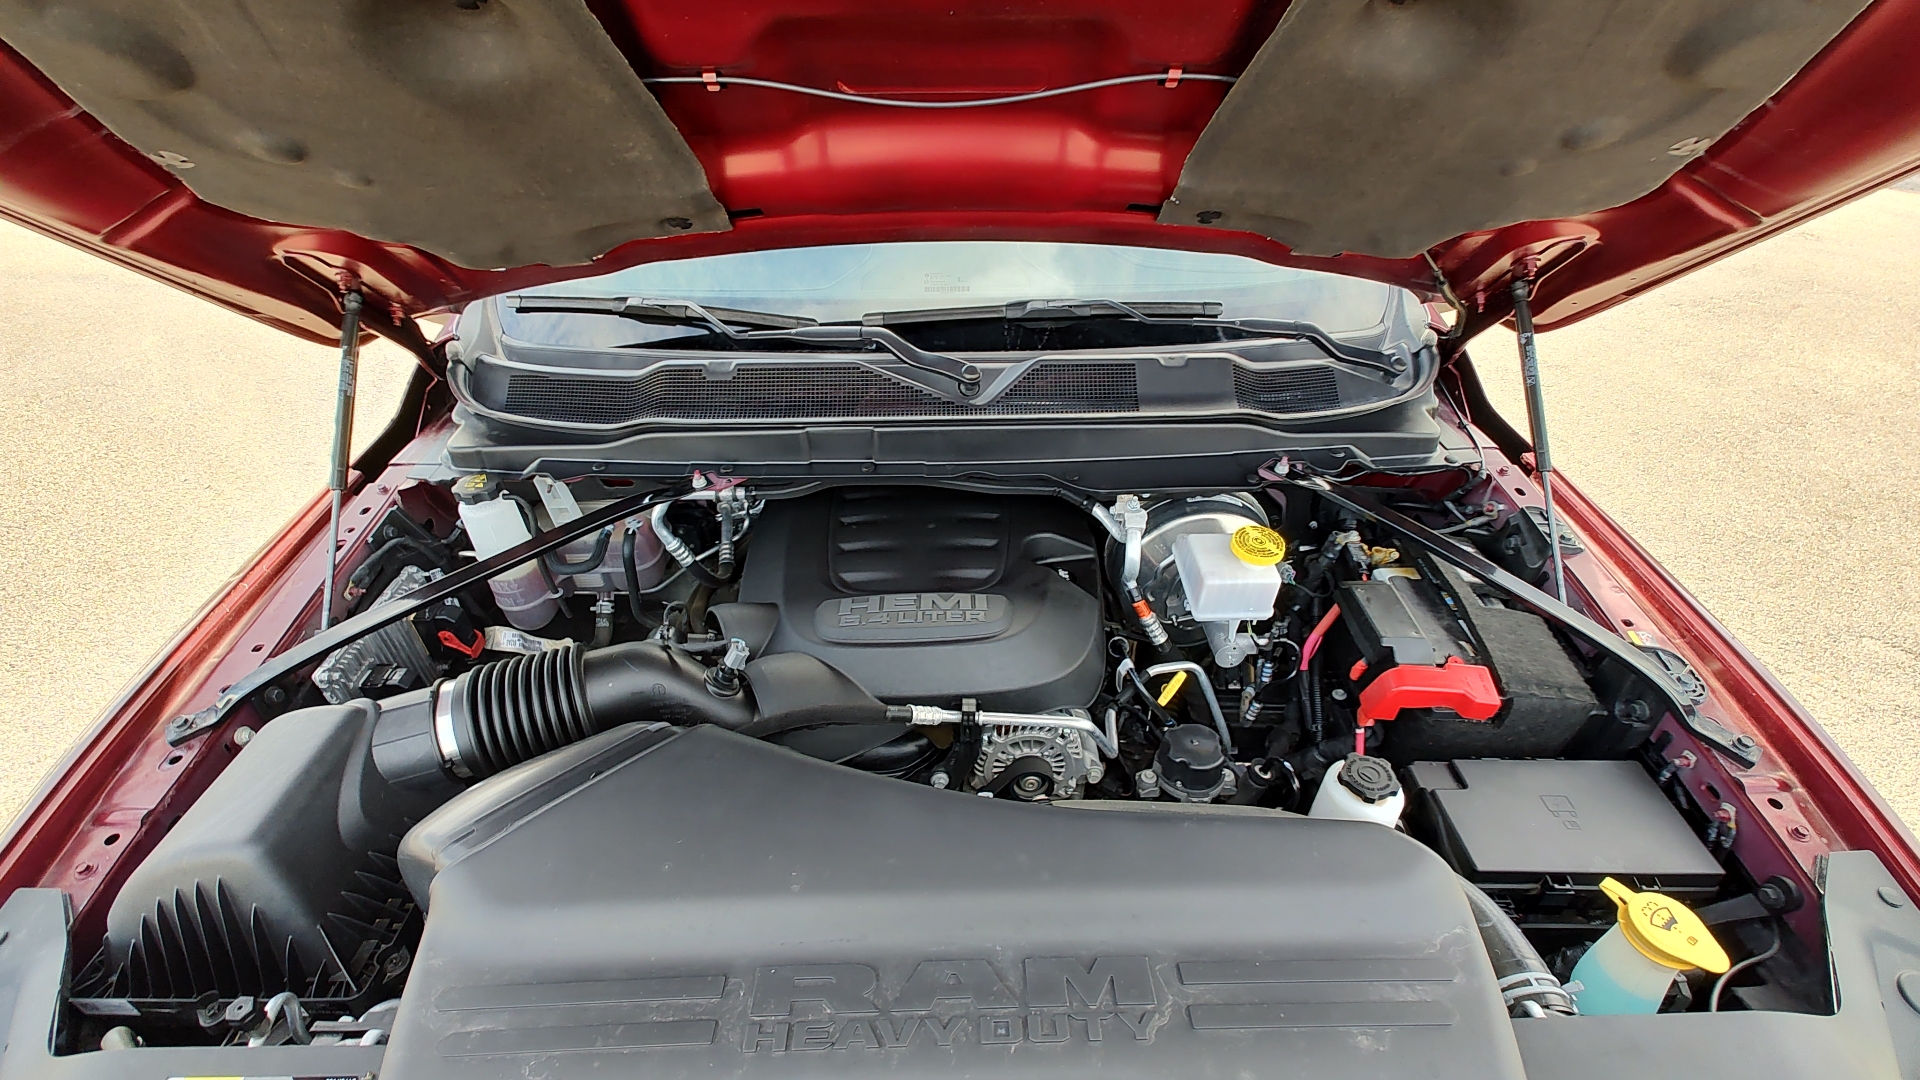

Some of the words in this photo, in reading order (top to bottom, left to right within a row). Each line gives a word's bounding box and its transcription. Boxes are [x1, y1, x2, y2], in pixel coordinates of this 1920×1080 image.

[838, 593, 989, 616] HEMI
[839, 610, 890, 627] 6.4
[899, 609, 987, 624] LITER
[749, 956, 1157, 1018] RAM
[743, 1017, 967, 1054] HEAVY
[979, 1010, 1157, 1046] DUTY
